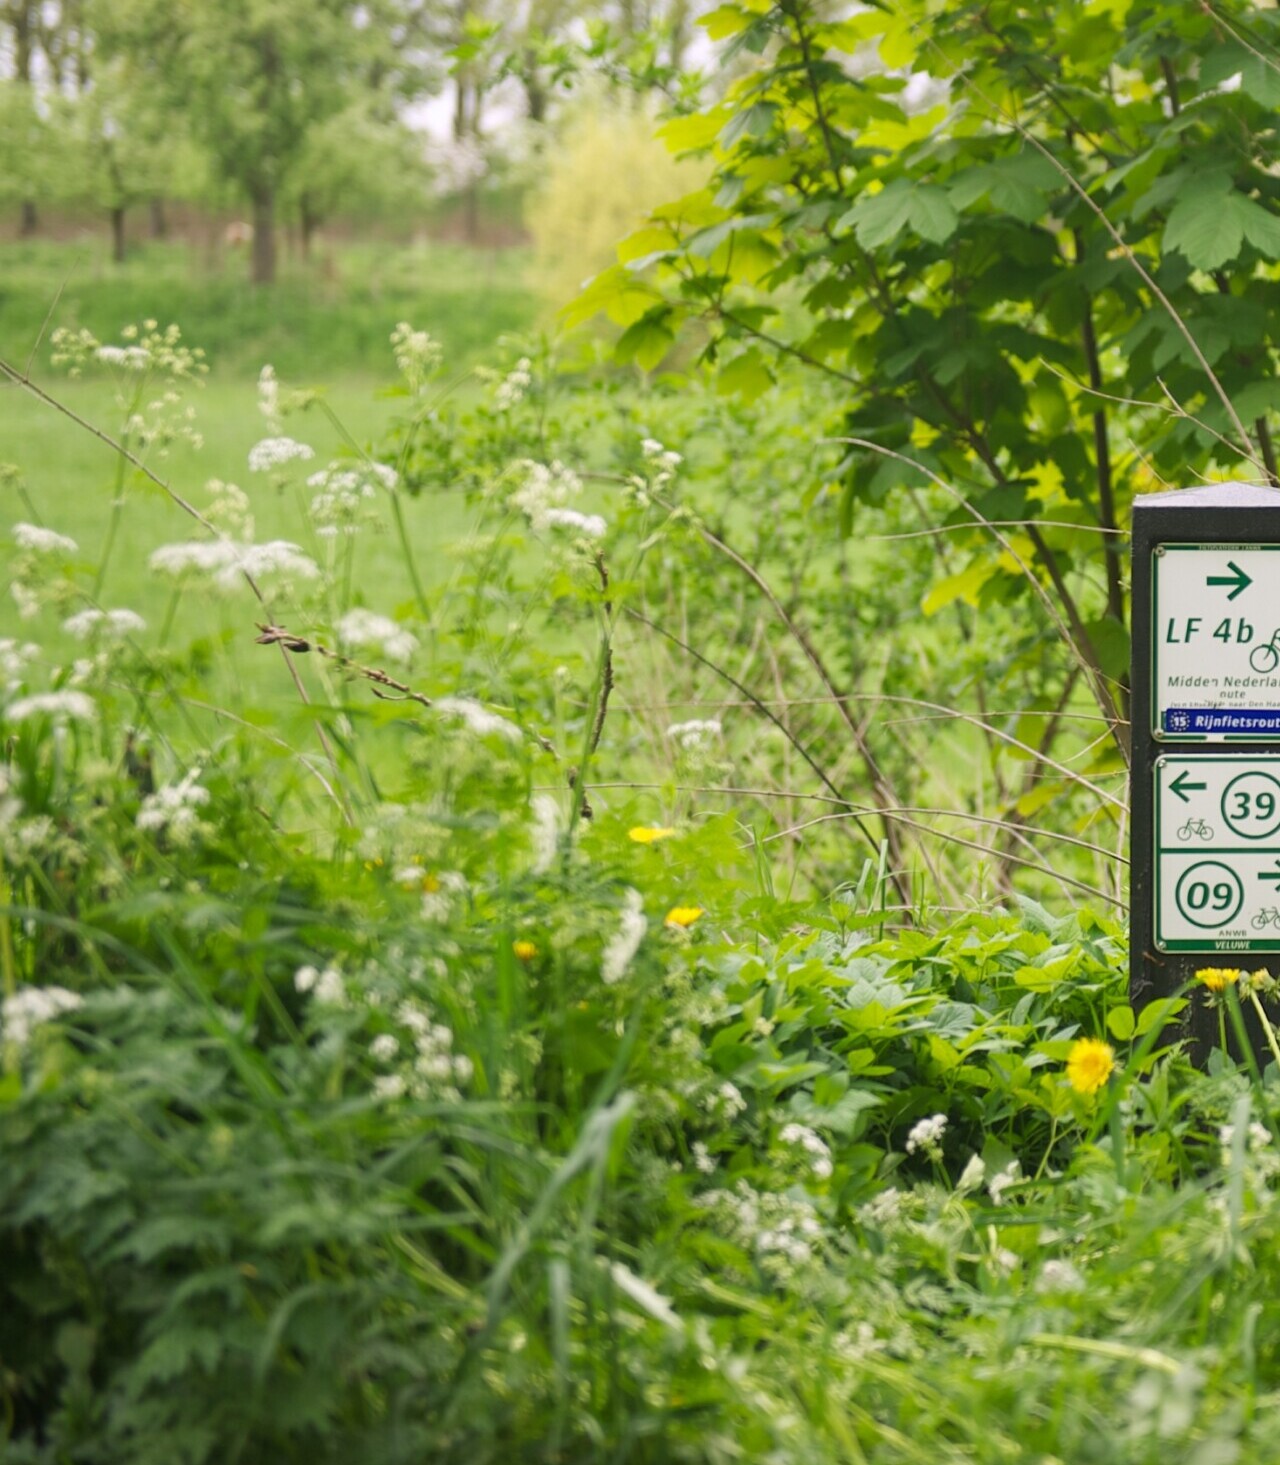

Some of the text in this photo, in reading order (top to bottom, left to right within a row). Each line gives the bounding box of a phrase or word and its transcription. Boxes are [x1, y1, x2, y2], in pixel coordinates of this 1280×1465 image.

[1166, 617, 1254, 643] LF 4b
[1174, 716, 1187, 727] 15
[1230, 792, 1276, 820] 39
[1186, 882, 1233, 910] 09
[1215, 941, 1251, 949] VELUWE
